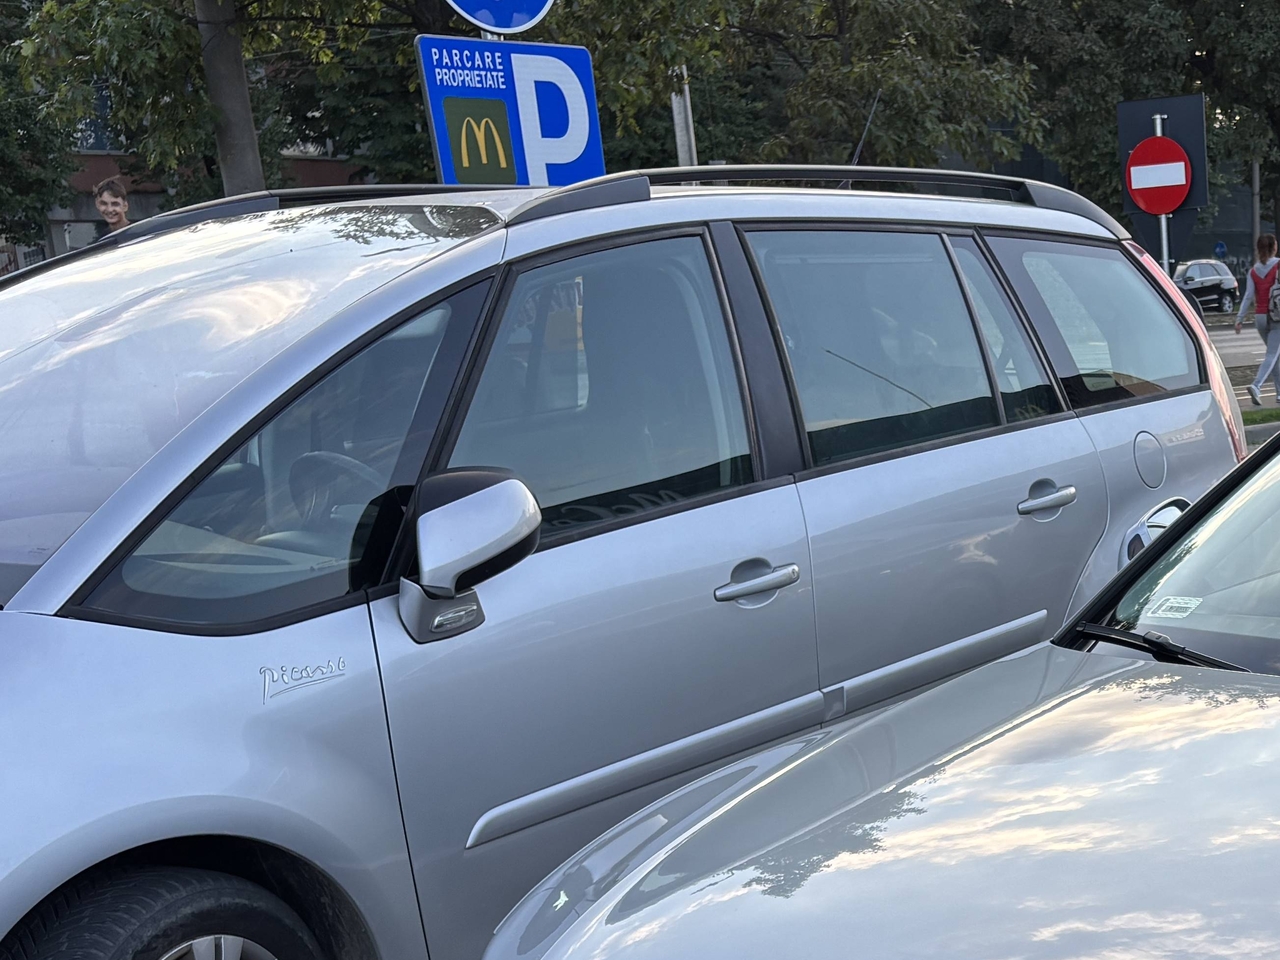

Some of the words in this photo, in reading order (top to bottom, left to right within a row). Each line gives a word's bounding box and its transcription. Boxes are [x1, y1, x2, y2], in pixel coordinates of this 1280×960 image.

[431, 48, 504, 70] PARCARE
[434, 68, 507, 89] PROPRIETATE
[511, 53, 590, 186] P
